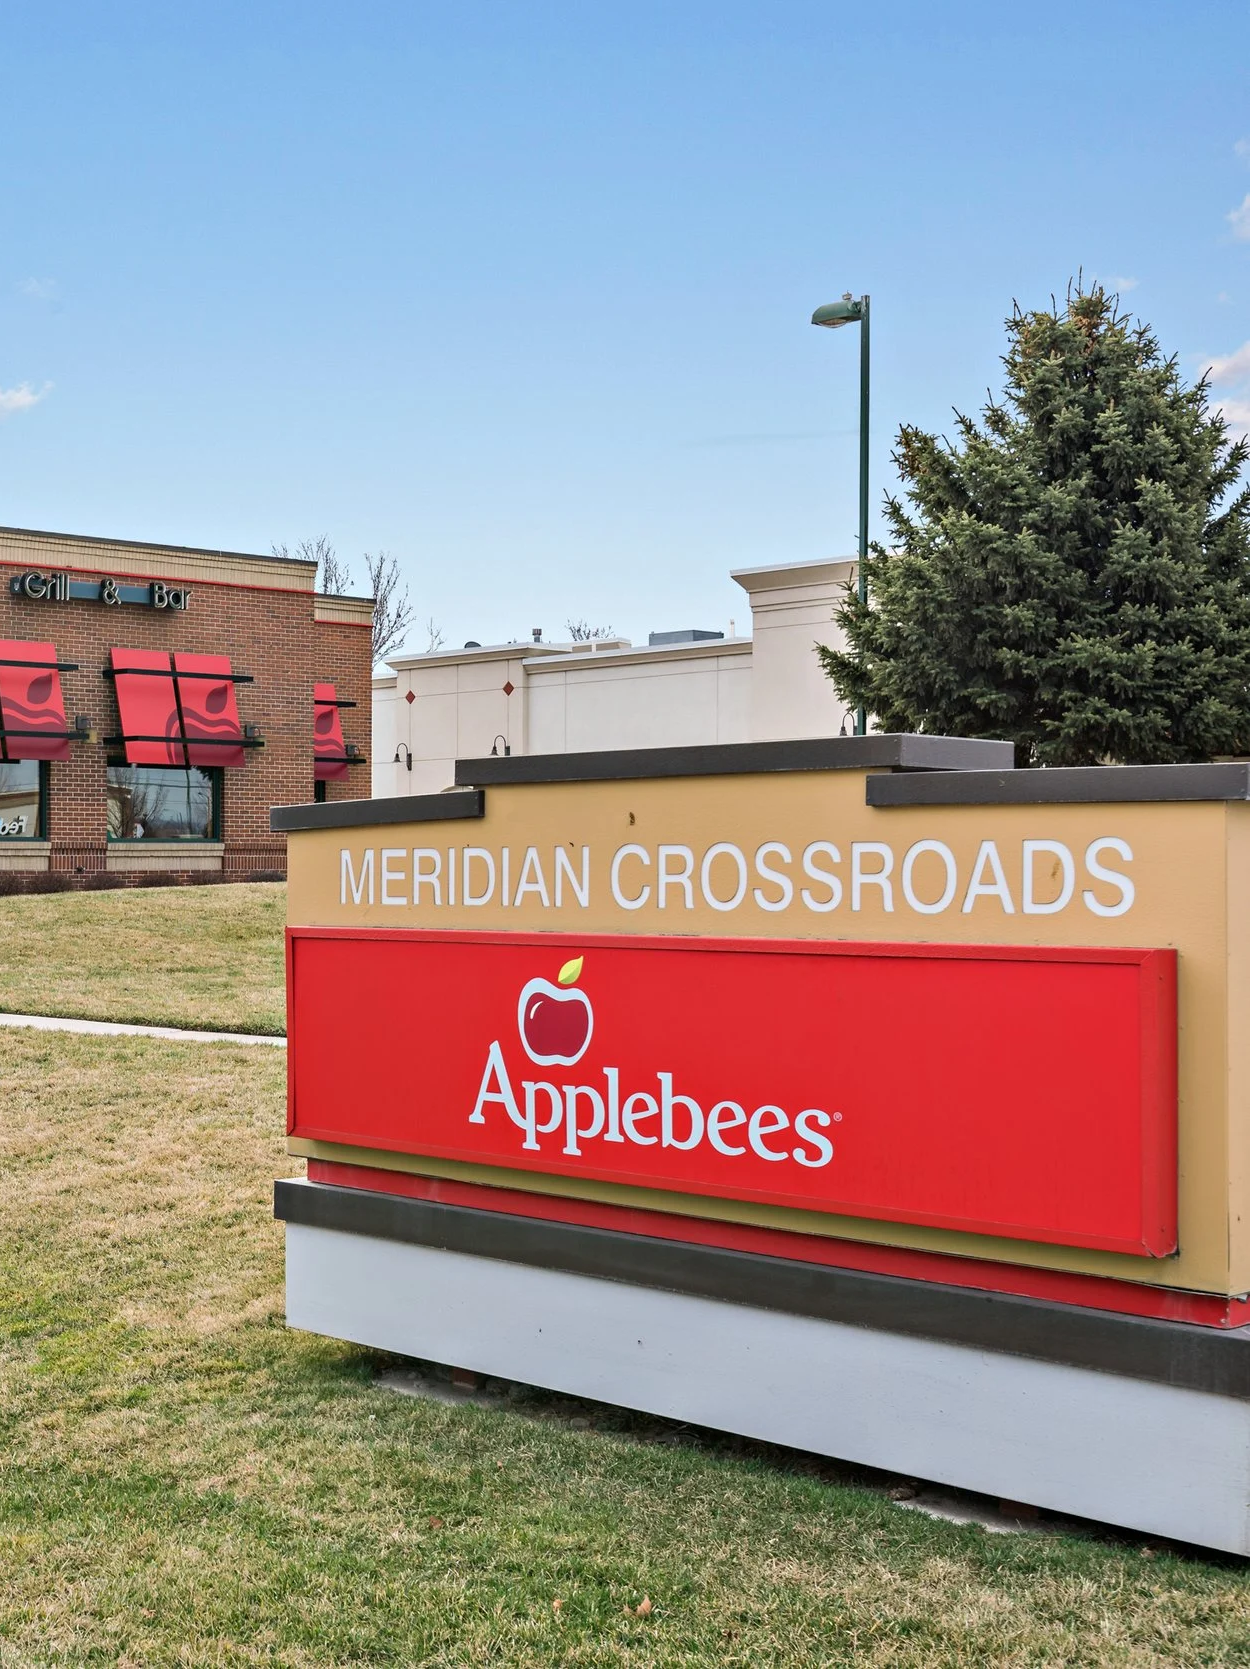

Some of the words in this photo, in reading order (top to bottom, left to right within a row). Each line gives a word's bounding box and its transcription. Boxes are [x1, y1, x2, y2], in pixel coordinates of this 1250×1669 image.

[23, 571, 70, 601] Grill
[101, 577, 122, 605] &
[151, 581, 193, 610] Bar
[339, 845, 590, 908] MERIDIAN
[609, 836, 1137, 917] CROSSROADS
